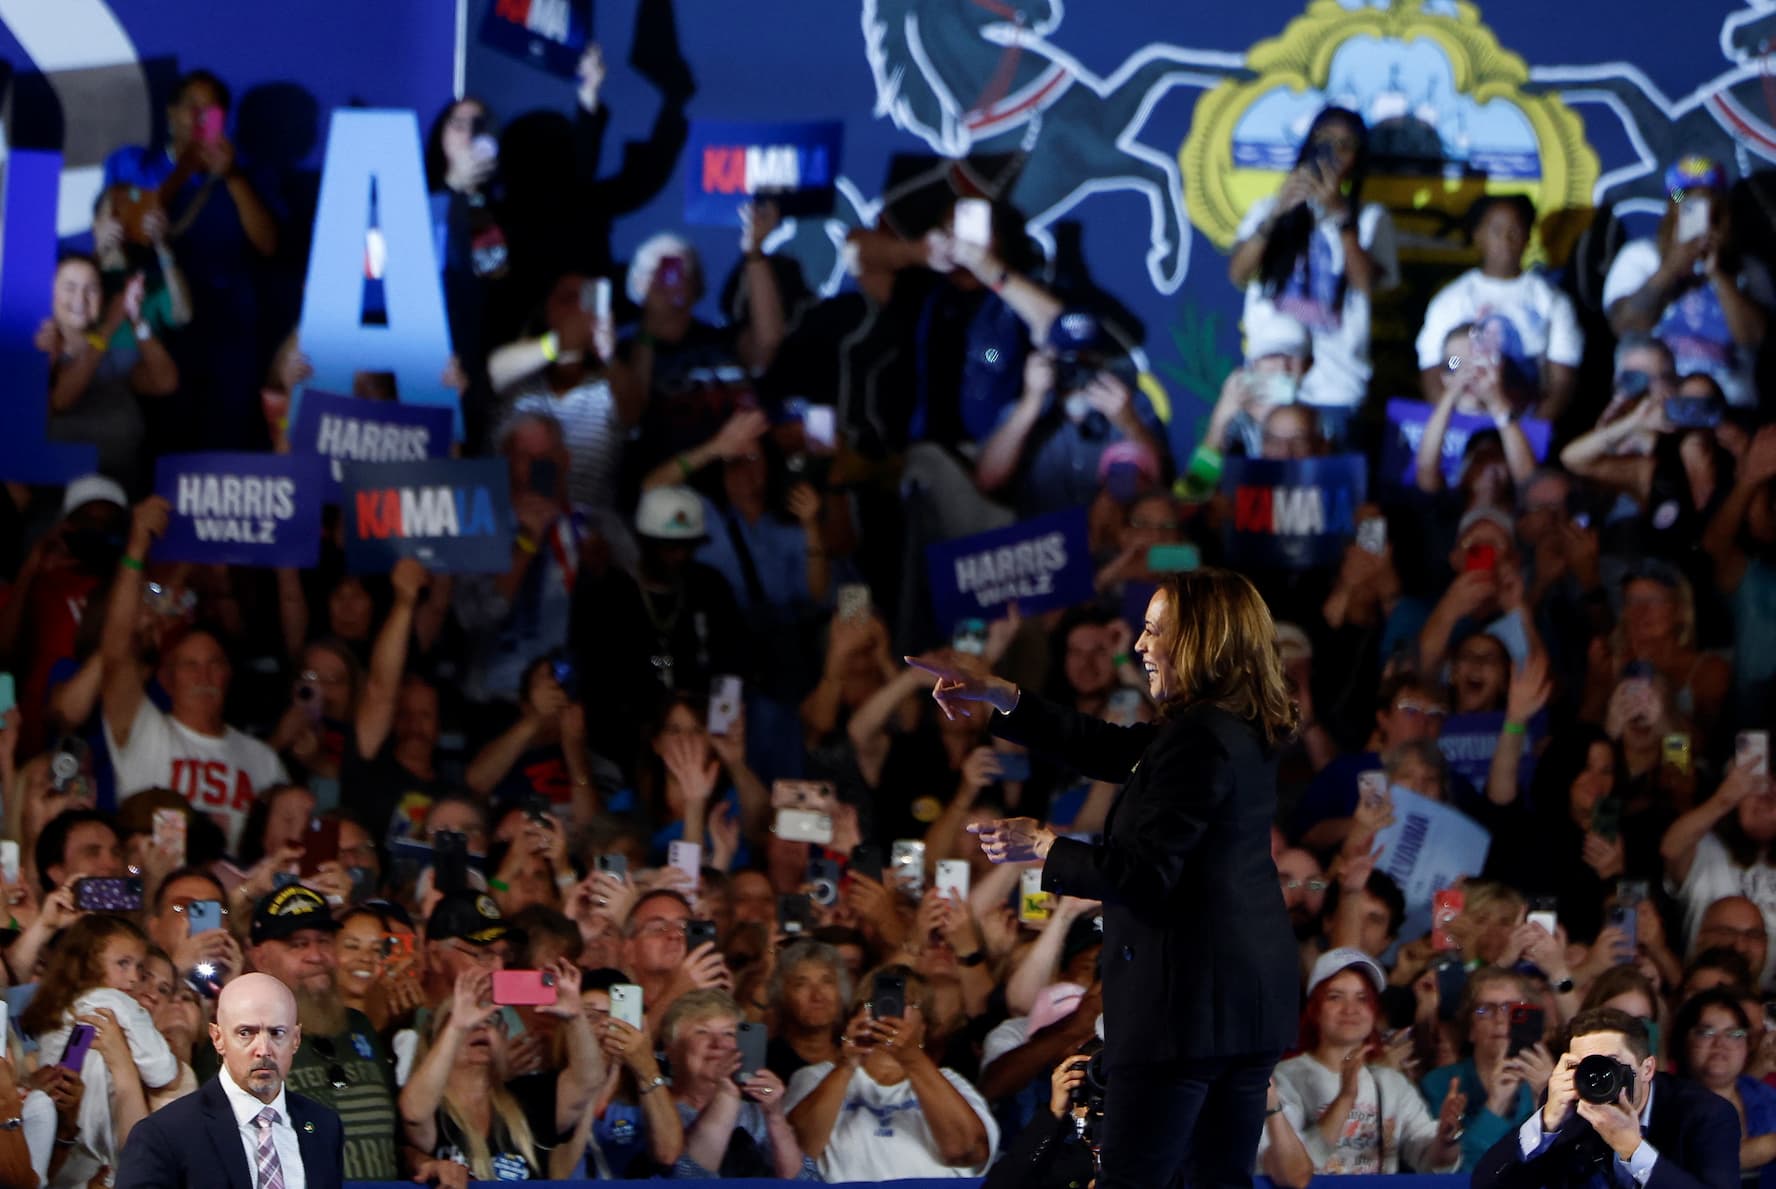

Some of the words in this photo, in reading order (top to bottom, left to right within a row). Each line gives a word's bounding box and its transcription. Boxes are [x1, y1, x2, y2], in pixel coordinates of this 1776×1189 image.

[317, 413, 430, 462] HARRIS
[178, 474, 295, 520] HARRIS
[356, 486, 496, 540] KAMALA
[194, 518, 277, 545] WALZ
[954, 531, 1068, 594] HARRIS
[975, 572, 1054, 608] WALZ
[170, 758, 257, 811] USA
